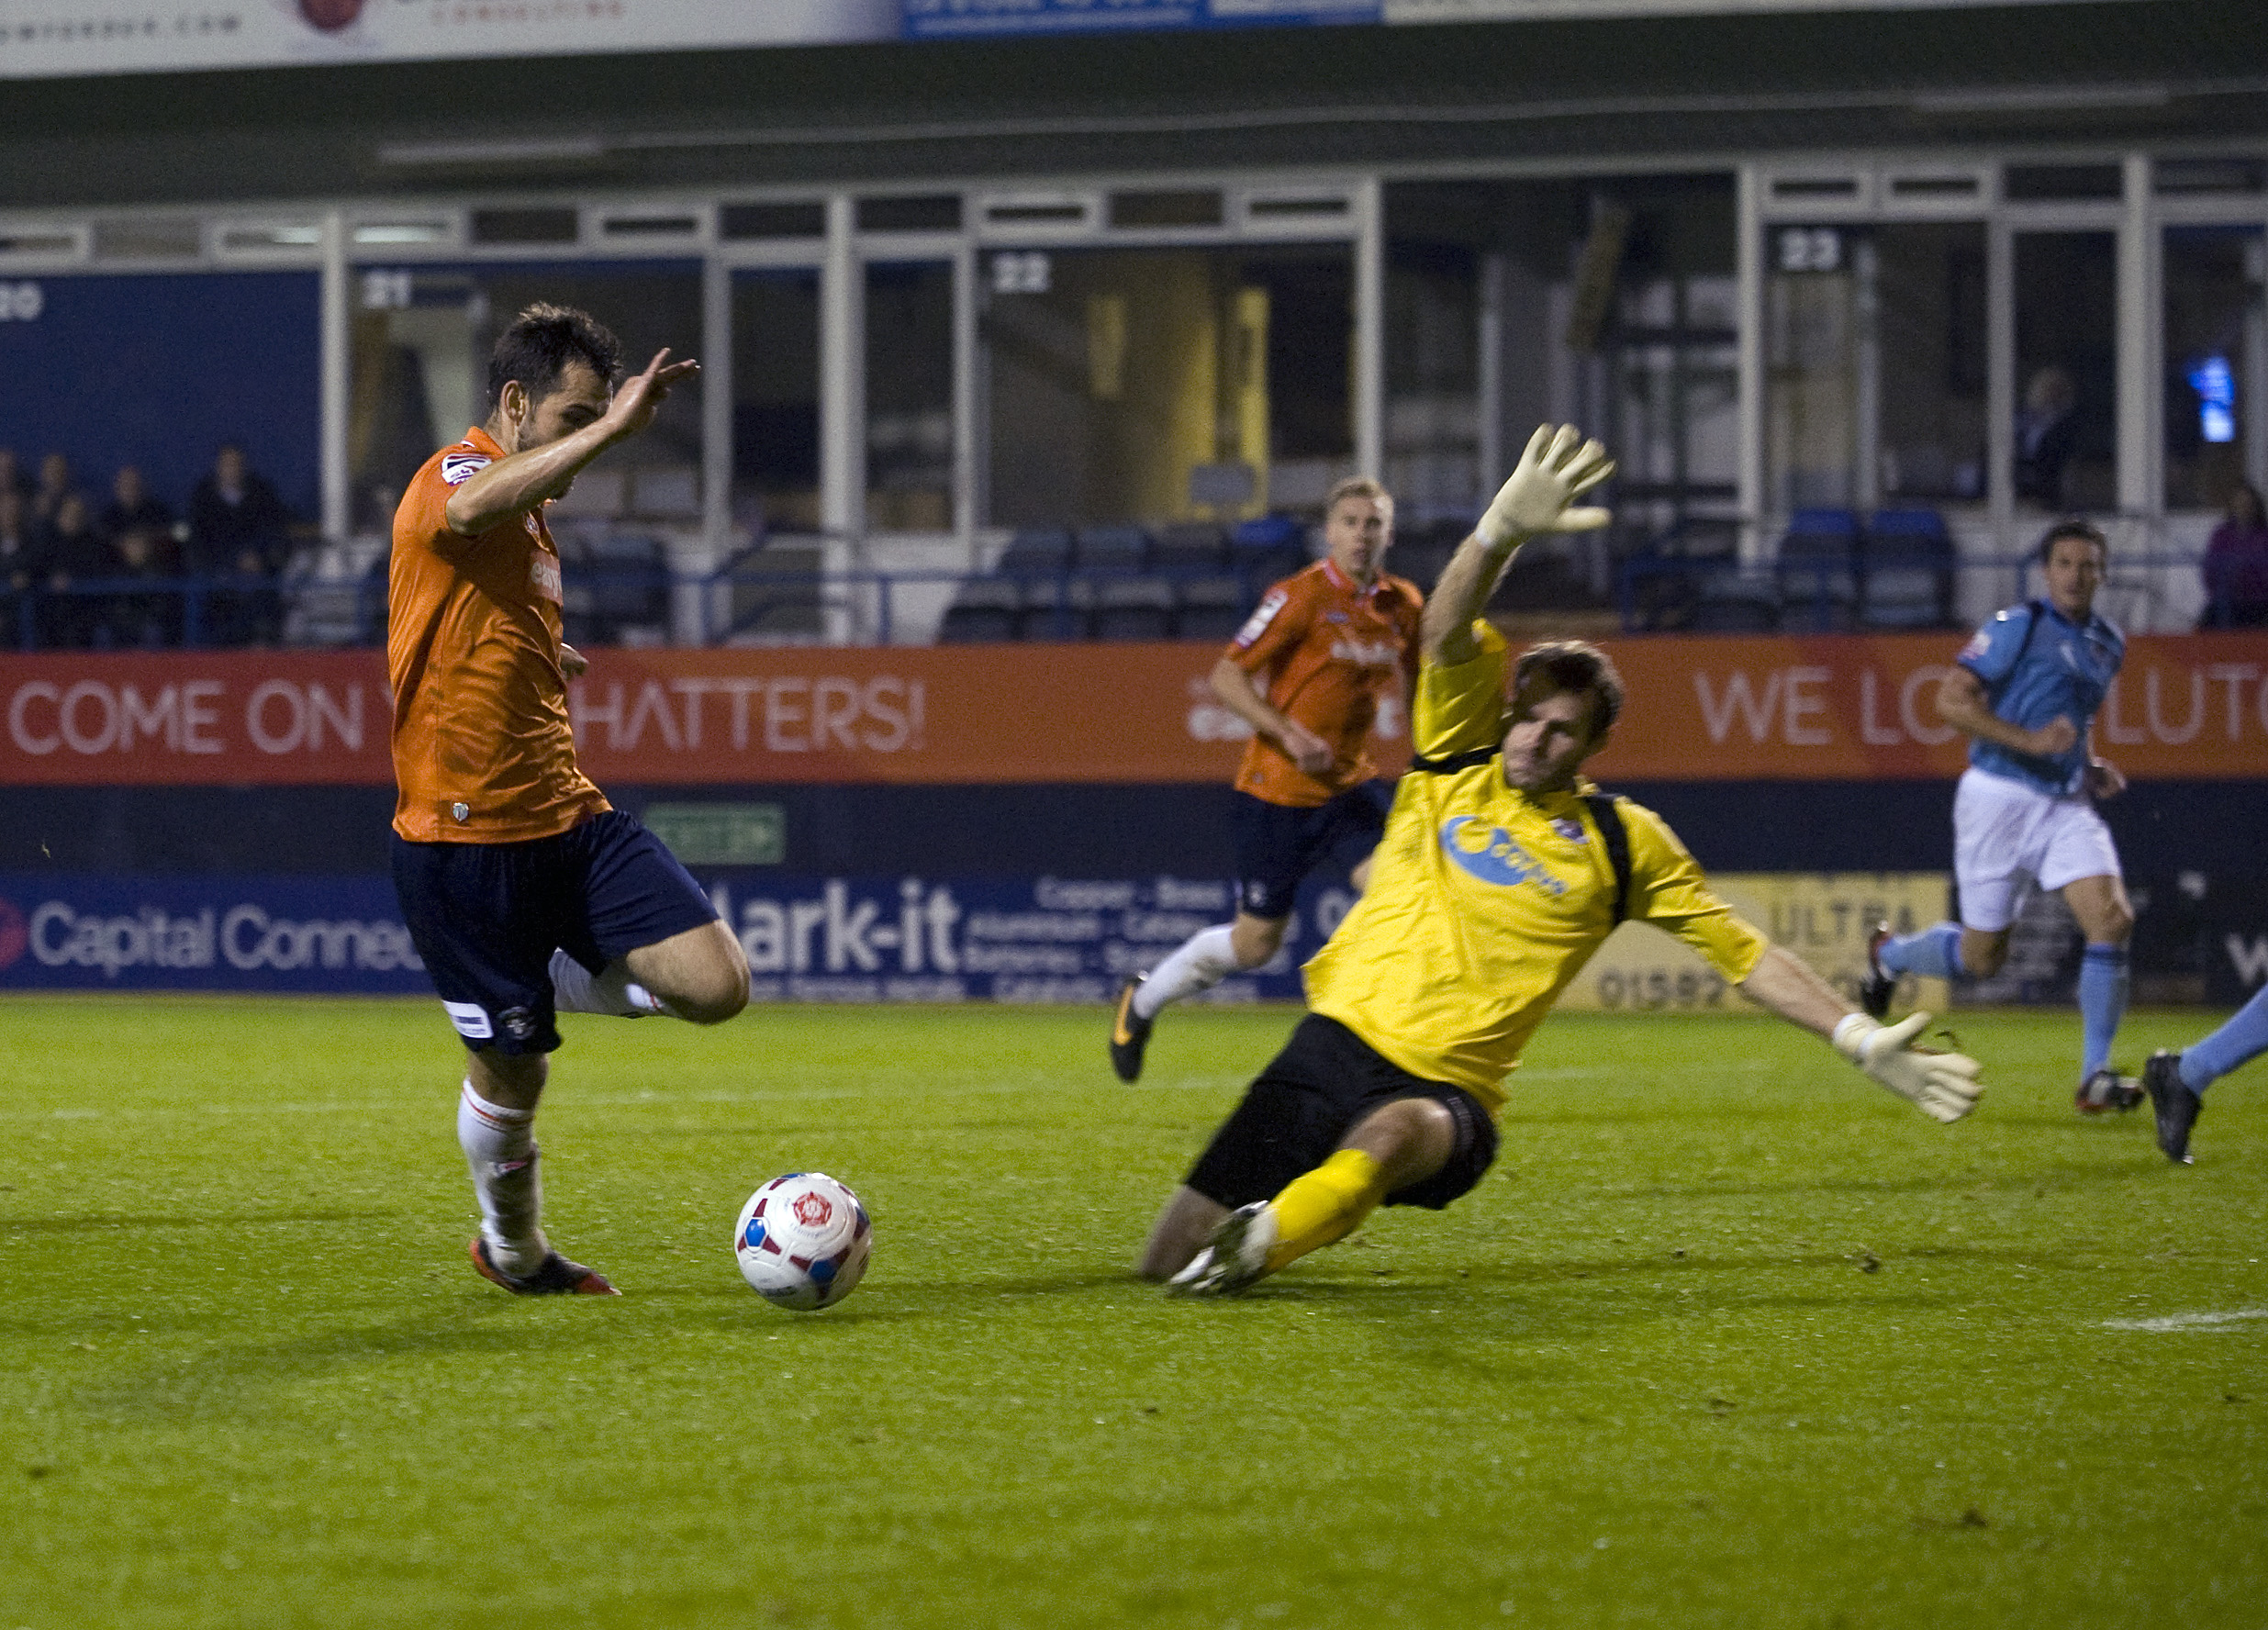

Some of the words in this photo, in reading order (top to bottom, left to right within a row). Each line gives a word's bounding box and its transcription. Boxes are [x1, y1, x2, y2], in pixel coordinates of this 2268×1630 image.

[993, 253, 1051, 294] 22
[8, 680, 226, 754] COME
[245, 678, 363, 754] ON
[567, 675, 925, 752] HATTERS!
[1693, 666, 1828, 745] WE
[1860, 665, 1958, 744] LO
[2108, 662, 2268, 744] LUT
[29, 899, 216, 977] Capital
[220, 903, 426, 970] Connec
[710, 877, 960, 973] ark-it
[1771, 900, 1916, 945] ULTRA
